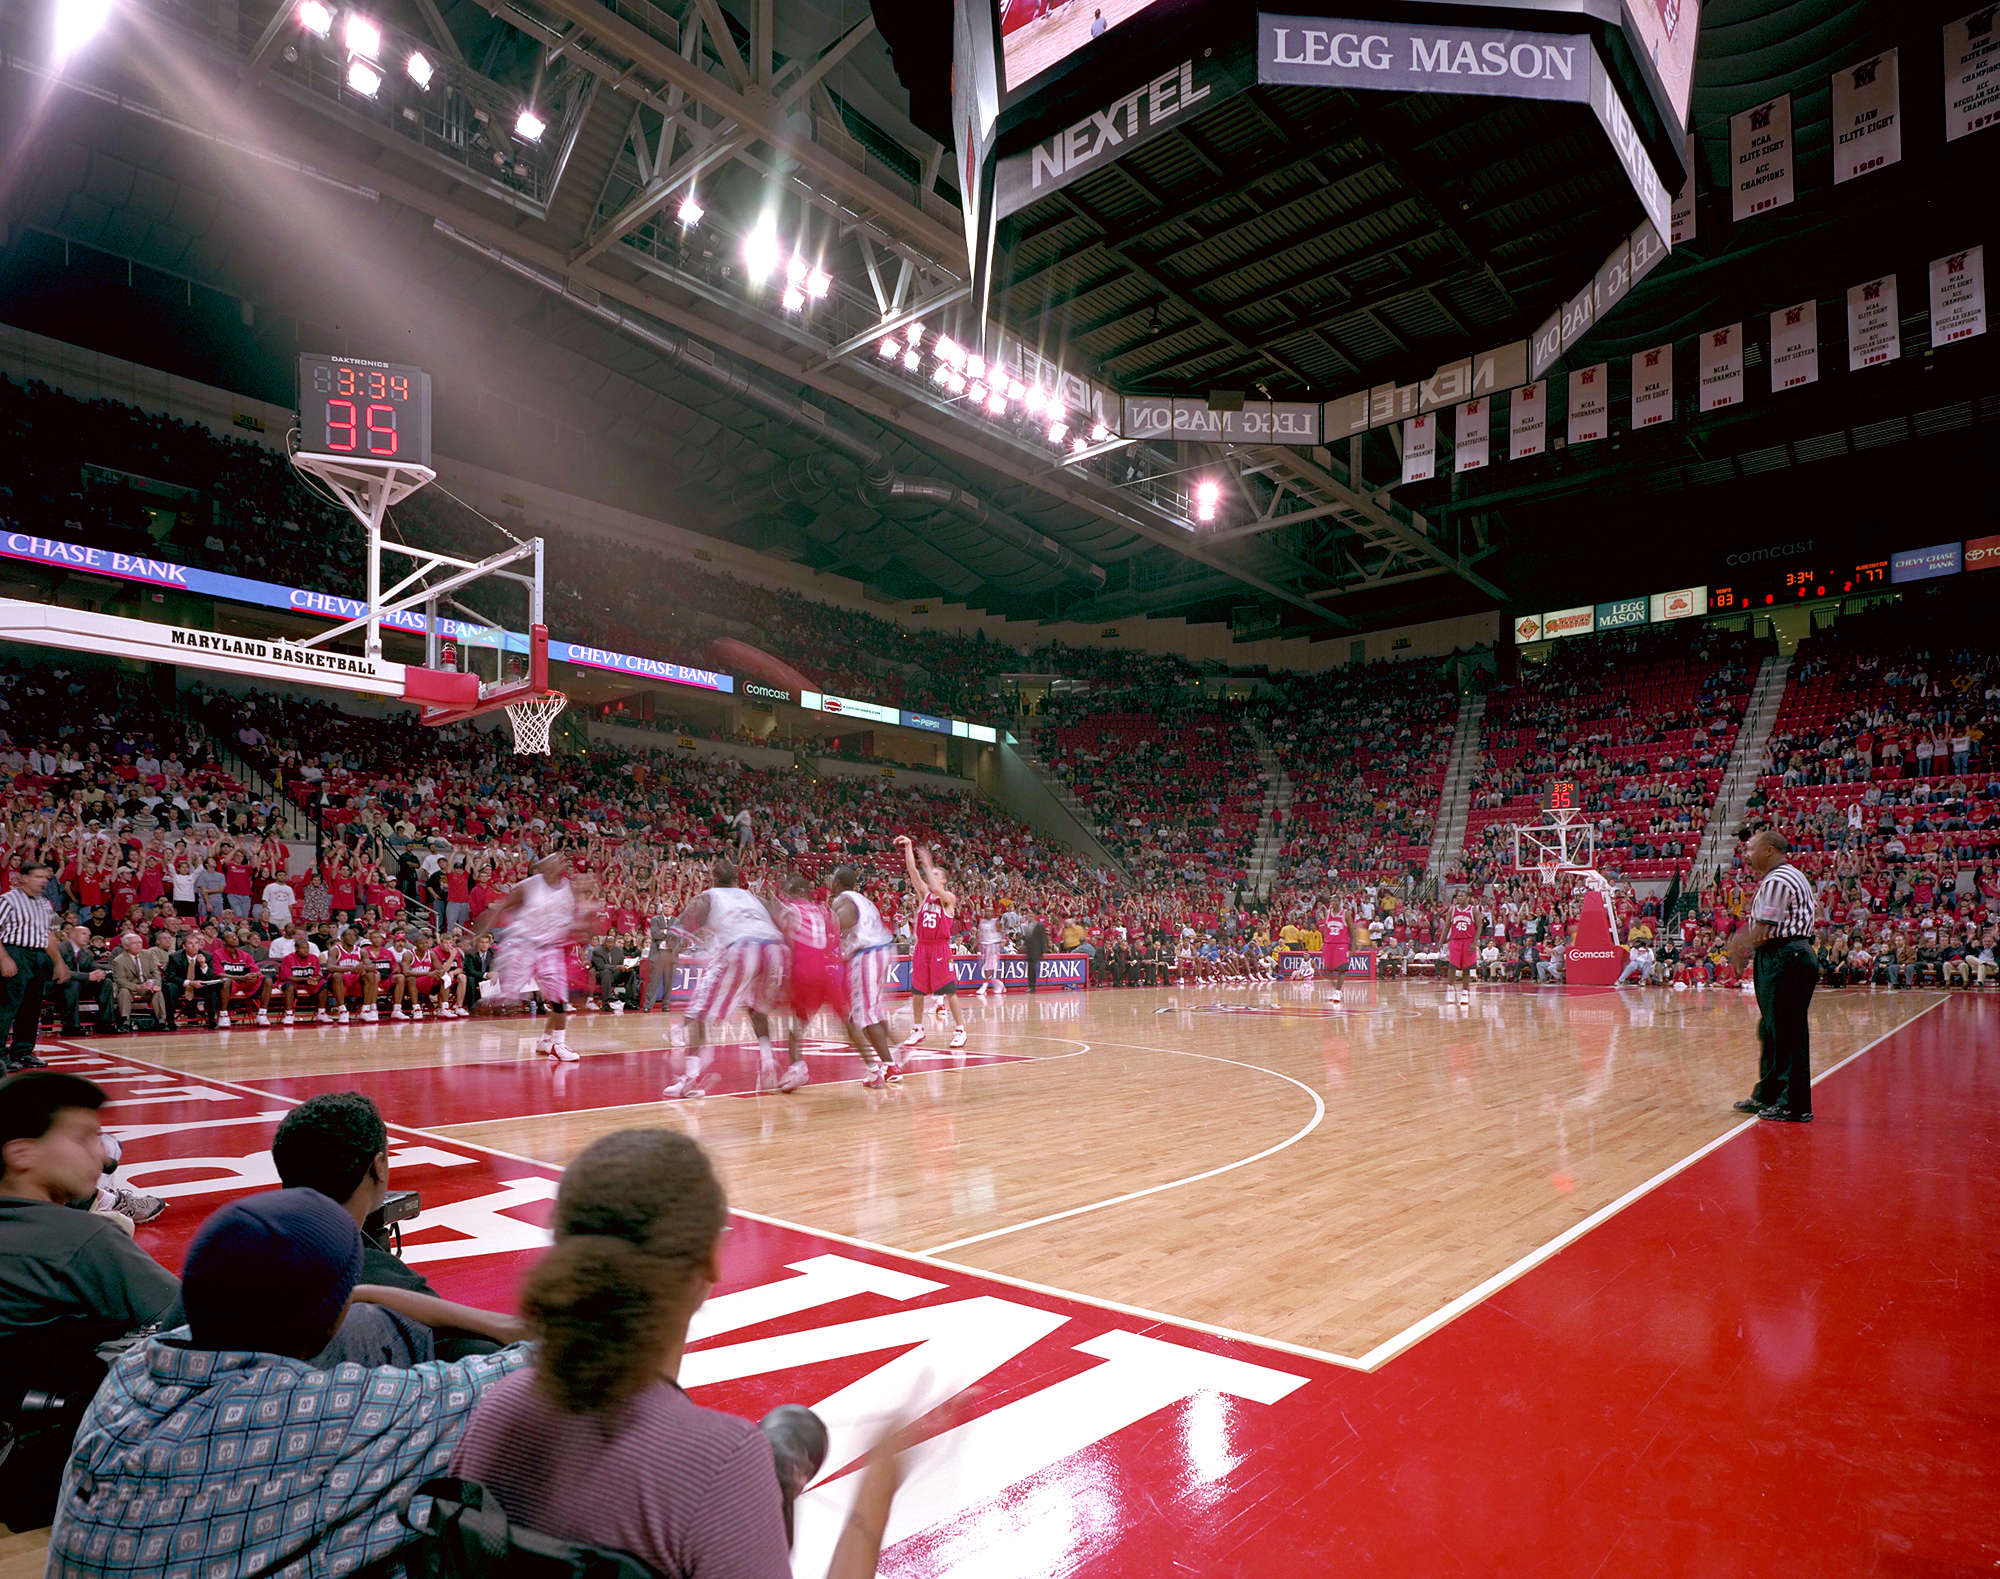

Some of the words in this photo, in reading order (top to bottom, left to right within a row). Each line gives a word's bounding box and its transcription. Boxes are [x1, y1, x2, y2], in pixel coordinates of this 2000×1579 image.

[1273, 28, 1393, 69] LEGG
[1409, 37, 1576, 80] MASON
[1031, 60, 1210, 189] NEXTEL
[1839, 126, 1865, 144] ELITE
[1867, 115, 1895, 134] EIGHT
[1606, 74, 1661, 222] NEXTEL
[1739, 148, 1761, 164] ELITE
[1762, 140, 1785, 156] EIGHT
[1751, 134, 1772, 149] NCAA
[1740, 168, 1785, 191] CHAMPIONS
[1755, 163, 1770, 175] ACC
[331, 356, 389, 368] DAKTRONICS
[339, 367, 409, 400] 3:34
[328, 399, 398, 456] 35
[8, 533, 102, 567] CHASE
[112, 552, 187, 583] BANK
[1726, 538, 1815, 566] comcast
[1929, 560, 1955, 571] BANK
[1786, 570, 1814, 586] 3:34
[289, 588, 366, 616] CHEVY
[1612, 600, 1646, 615] LEGG
[1598, 611, 1646, 628] MASON
[171, 630, 267, 658] MARYLAND
[272, 646, 377, 676] BASKETBALL
[567, 644, 623, 666] CHEVY
[625, 655, 675, 677] CHASE
[678, 666, 719, 686] BANK
[920, 718, 940, 729] PEPSI
[1551, 792, 1572, 809] 35
[1456, 921, 1467, 932] 45
[1039, 960, 1081, 979] BANK
[1348, 956, 1369, 970] ANK
